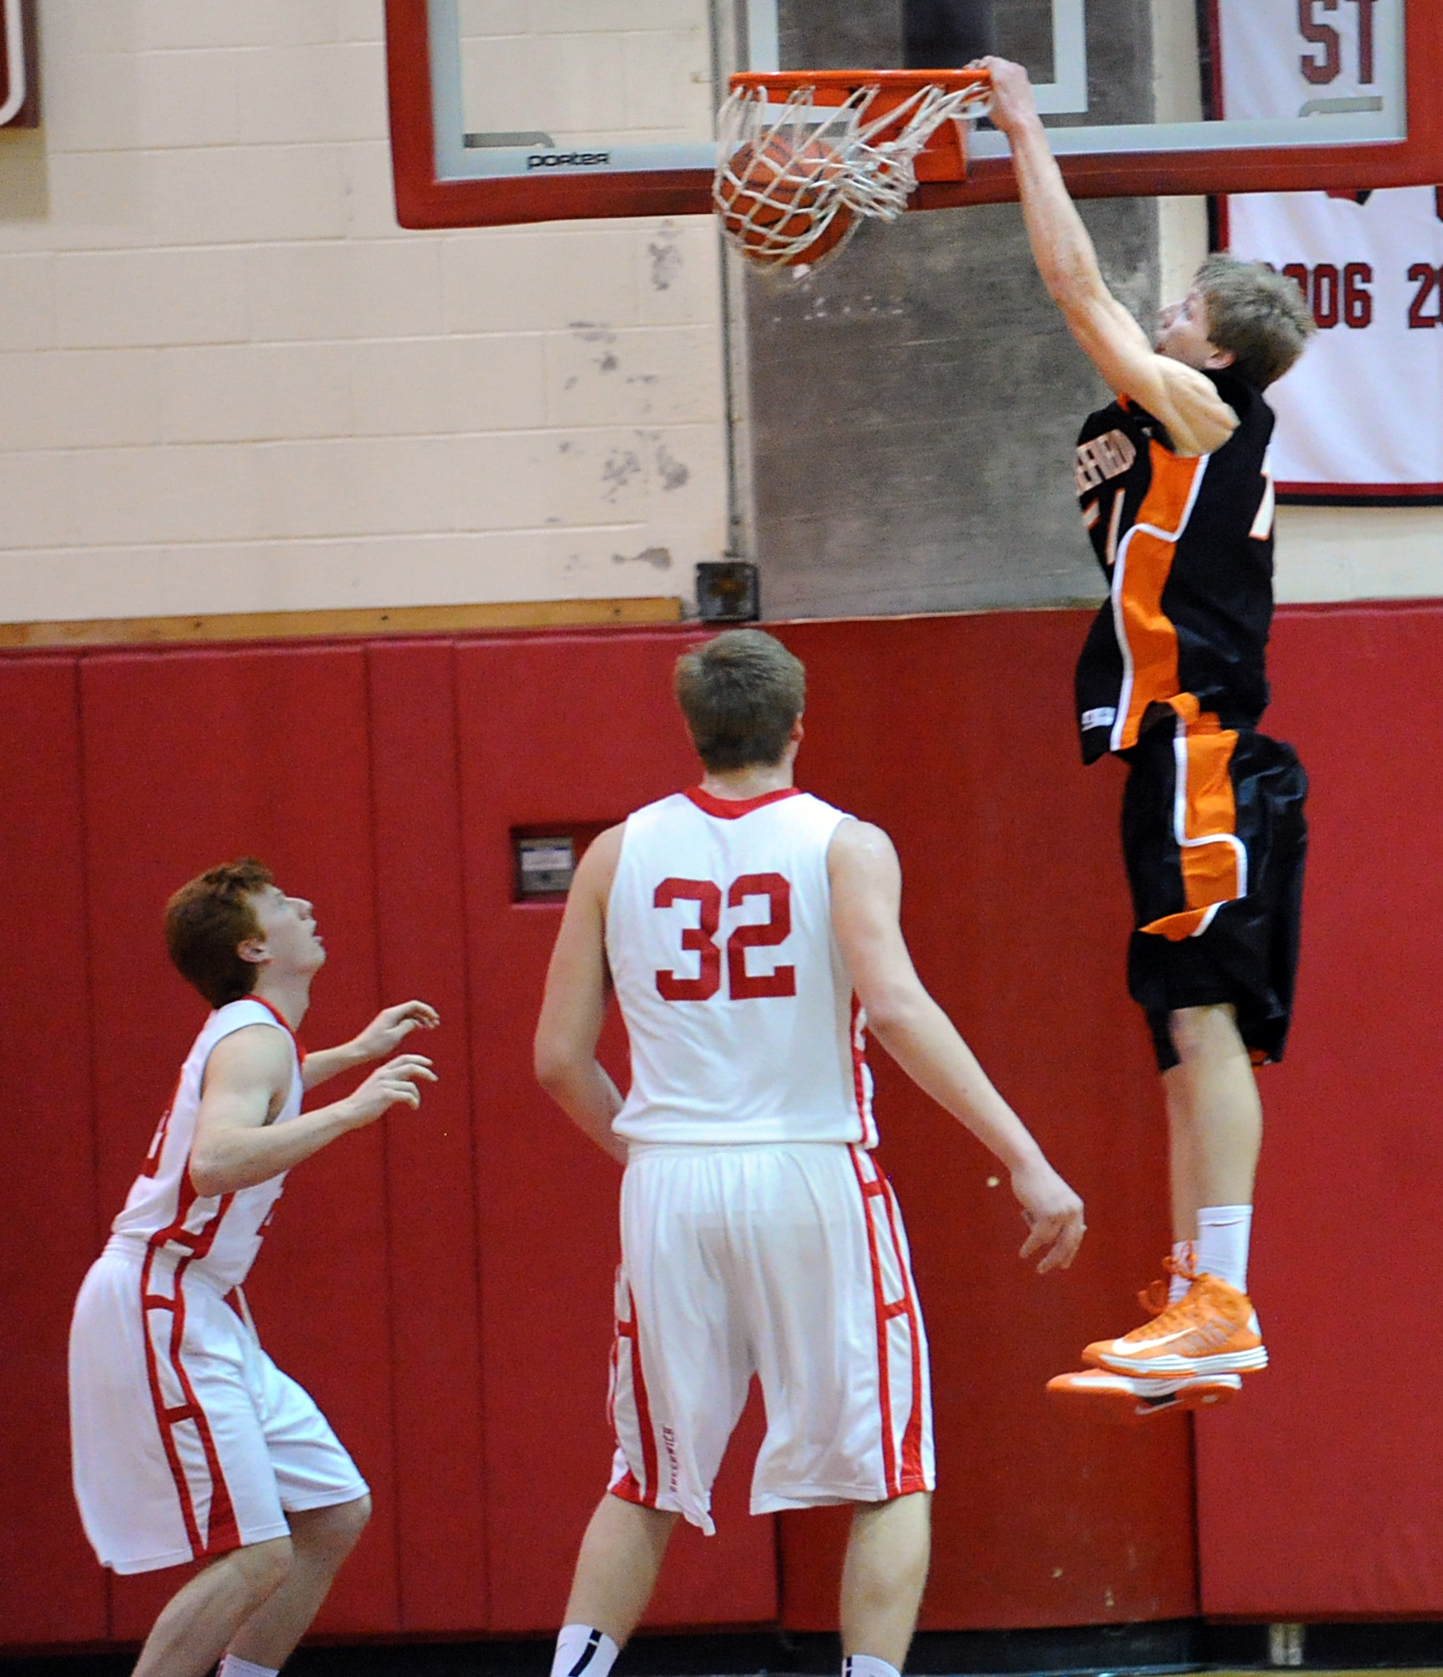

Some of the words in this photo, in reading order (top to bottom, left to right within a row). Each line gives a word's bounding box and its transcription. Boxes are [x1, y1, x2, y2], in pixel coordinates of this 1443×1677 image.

[1298, 0, 1378, 84] ST
[1263, 262, 1372, 329] 06
[1406, 262, 1443, 329] 2
[653, 872, 796, 1001] 32
